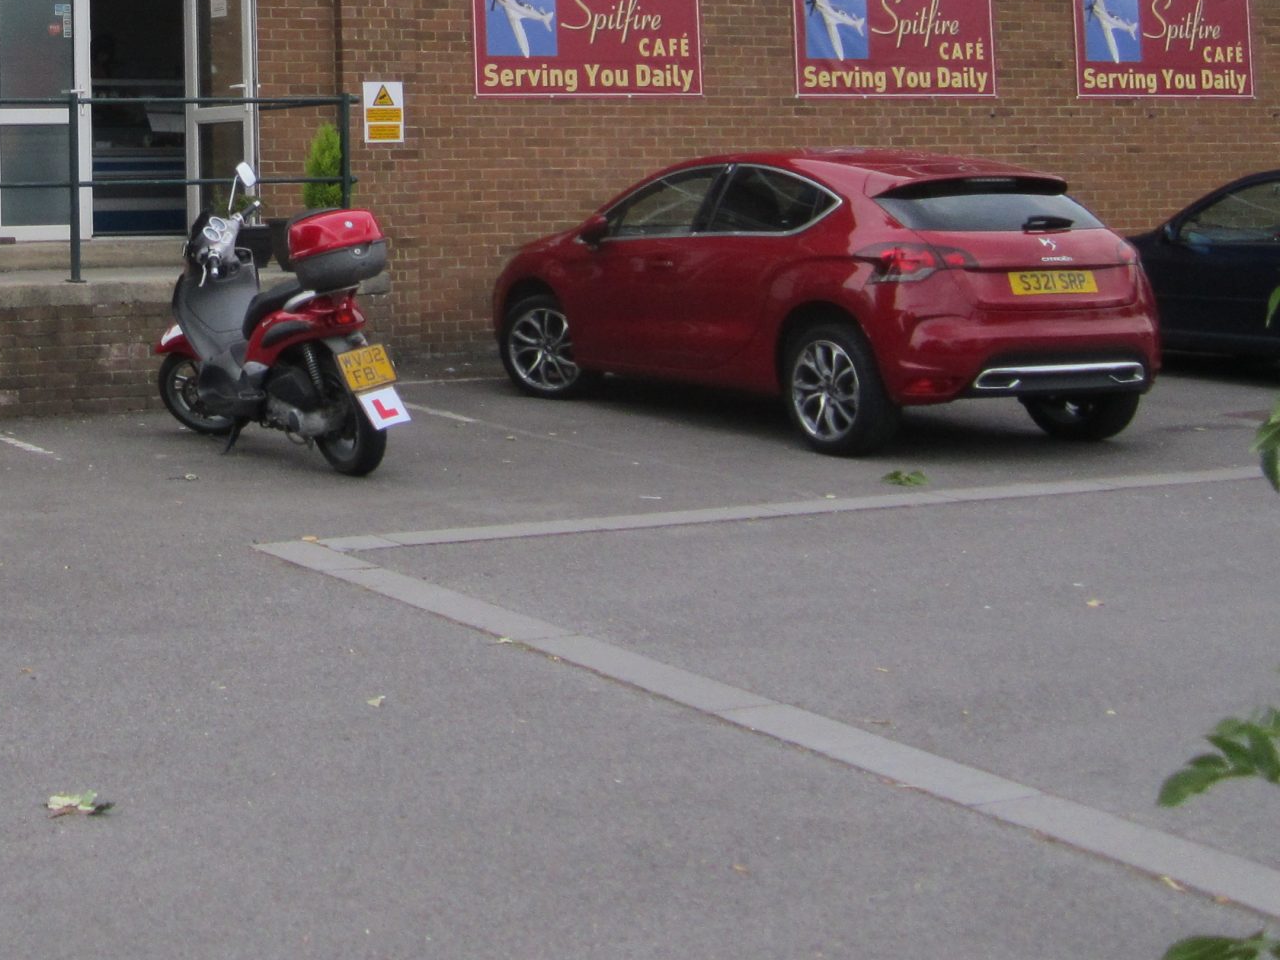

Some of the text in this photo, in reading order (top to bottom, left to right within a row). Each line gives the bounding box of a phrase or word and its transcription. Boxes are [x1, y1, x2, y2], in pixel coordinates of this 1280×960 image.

[638, 33, 689, 57] CAFÉ
[939, 38, 984, 60] CAFÉ
[1203, 41, 1243, 63] CAFÉ
[484, 64, 694, 92] Serving You Daily
[803, 66, 988, 93] Serving You Daily
[1083, 68, 1247, 93] Serving You Daily
[1020, 273, 1086, 291] S321 SRP
[371, 398, 399, 420] L
